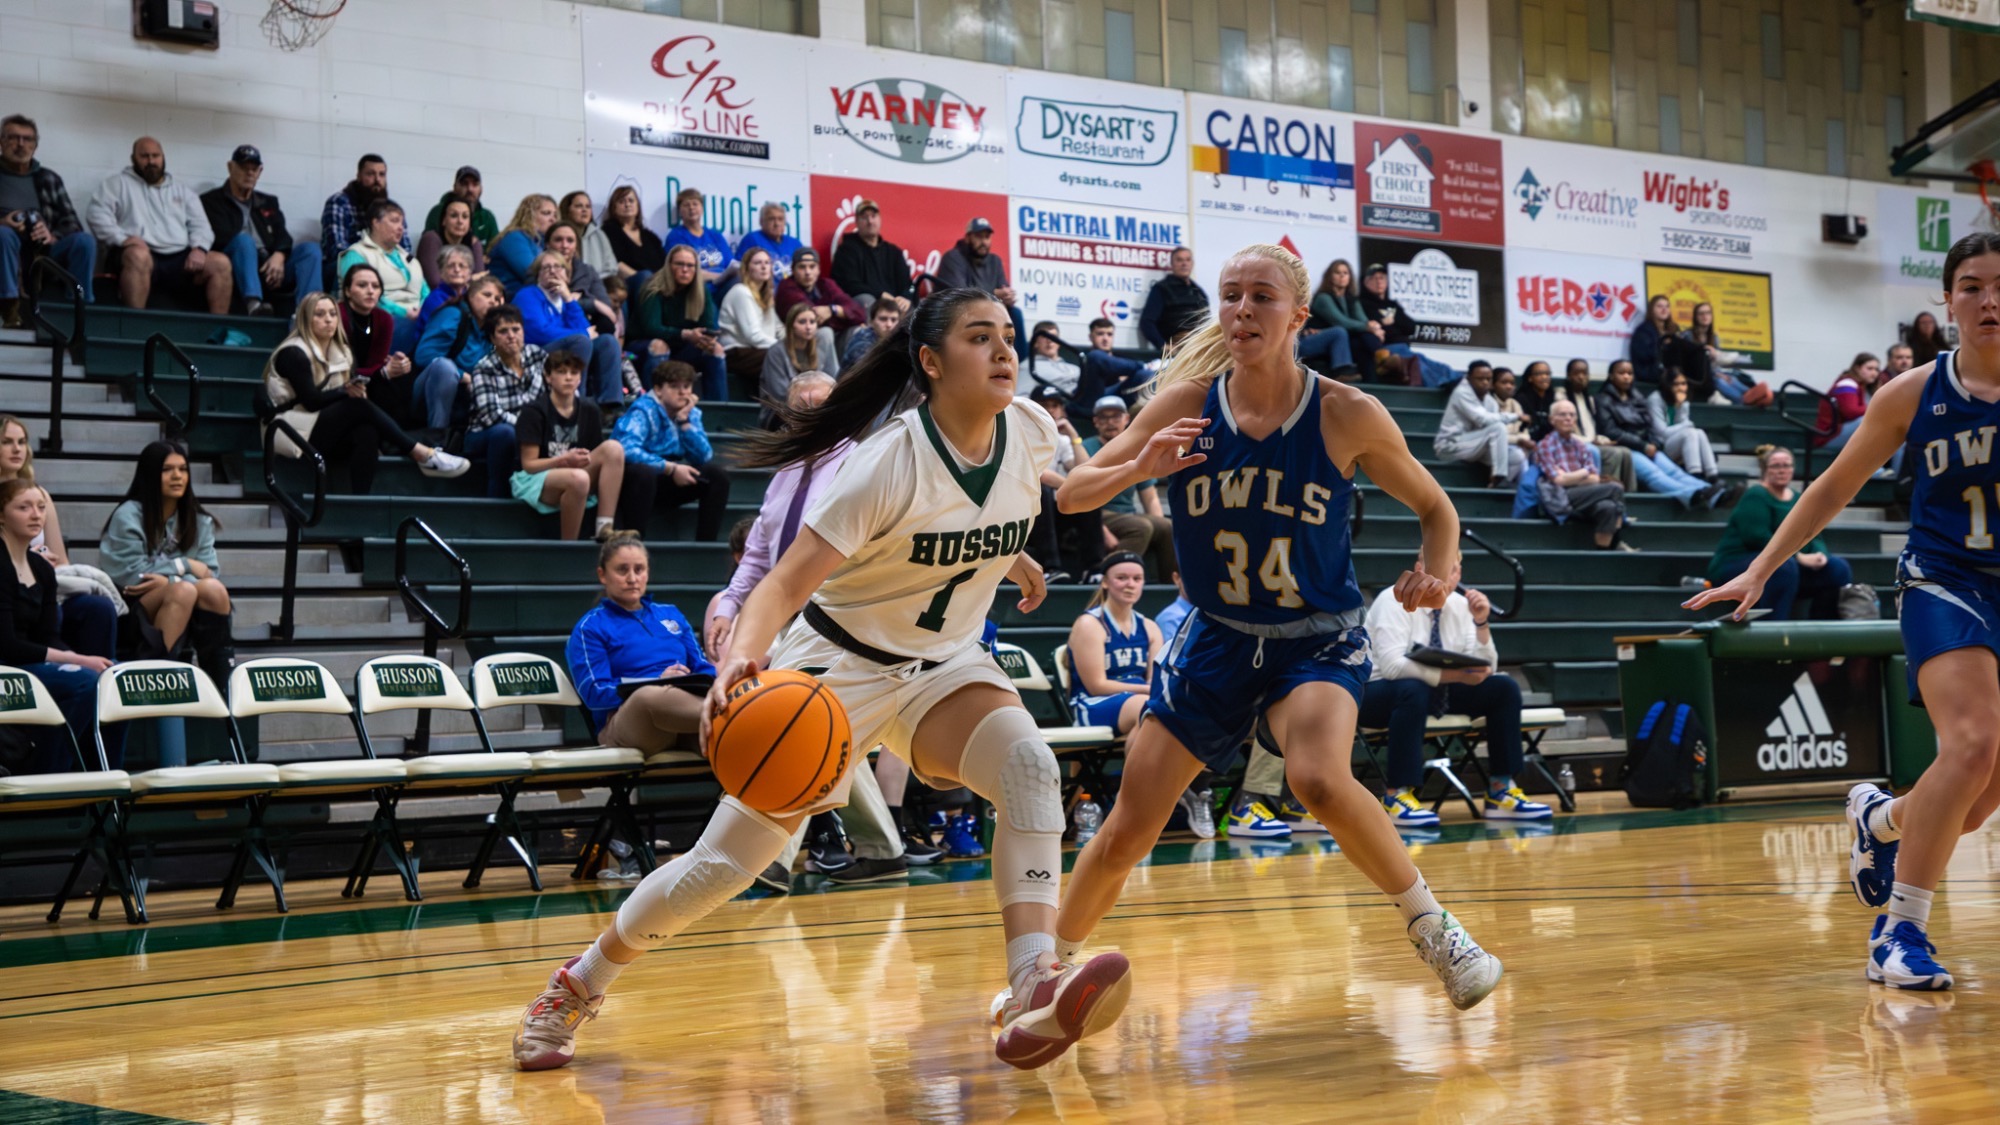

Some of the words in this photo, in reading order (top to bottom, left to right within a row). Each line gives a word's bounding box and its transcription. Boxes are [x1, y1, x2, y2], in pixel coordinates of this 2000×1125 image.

[830, 86, 987, 132] VARNEY
[1040, 102, 1155, 143] DYSART'S
[703, 109, 759, 138] LINE
[814, 124, 849, 136] BUICK
[863, 130, 912, 145] PONTIAC
[925, 138, 953, 150] GMC
[1206, 109, 1335, 162] CARON
[1061, 137, 1145, 160] Restaurant
[1059, 172, 1141, 190] dysarts.com
[1382, 161, 1418, 178] FIRST
[1375, 176, 1427, 194] CHOICE
[1643, 170, 1730, 213] Wight's
[667, 175, 803, 240] DwnEt
[1555, 181, 1638, 218] Creative
[1018, 205, 1110, 238] CENTRAL
[1115, 216, 1182, 244] MAINE
[1024, 238, 1081, 260] MOVING
[1082, 246, 1093, 261] &
[1095, 247, 1156, 266] STORAGE
[1019, 268, 1087, 288] MOVING
[1092, 274, 1142, 293] MAINE
[1901, 256, 1944, 280] Holida
[1393, 271, 1434, 296] SCHOOL
[1435, 275, 1473, 299] STREET
[1186, 467, 1331, 525] OWLS
[1962, 482, 2000, 549] 1
[908, 518, 1029, 566] HUSSON
[1213, 529, 1304, 608] 34
[915, 568, 978, 632] 1
[1000, 653, 1024, 669] SON
[1105, 647, 1149, 670] WL
[122, 672, 190, 693] HUSSON
[254, 670, 317, 688] HUSSON
[379, 667, 438, 684] HUSSON
[495, 665, 550, 684] HUSSON
[258, 687, 318, 696] UNIVERSITY
[1757, 734, 1848, 771] adidas
